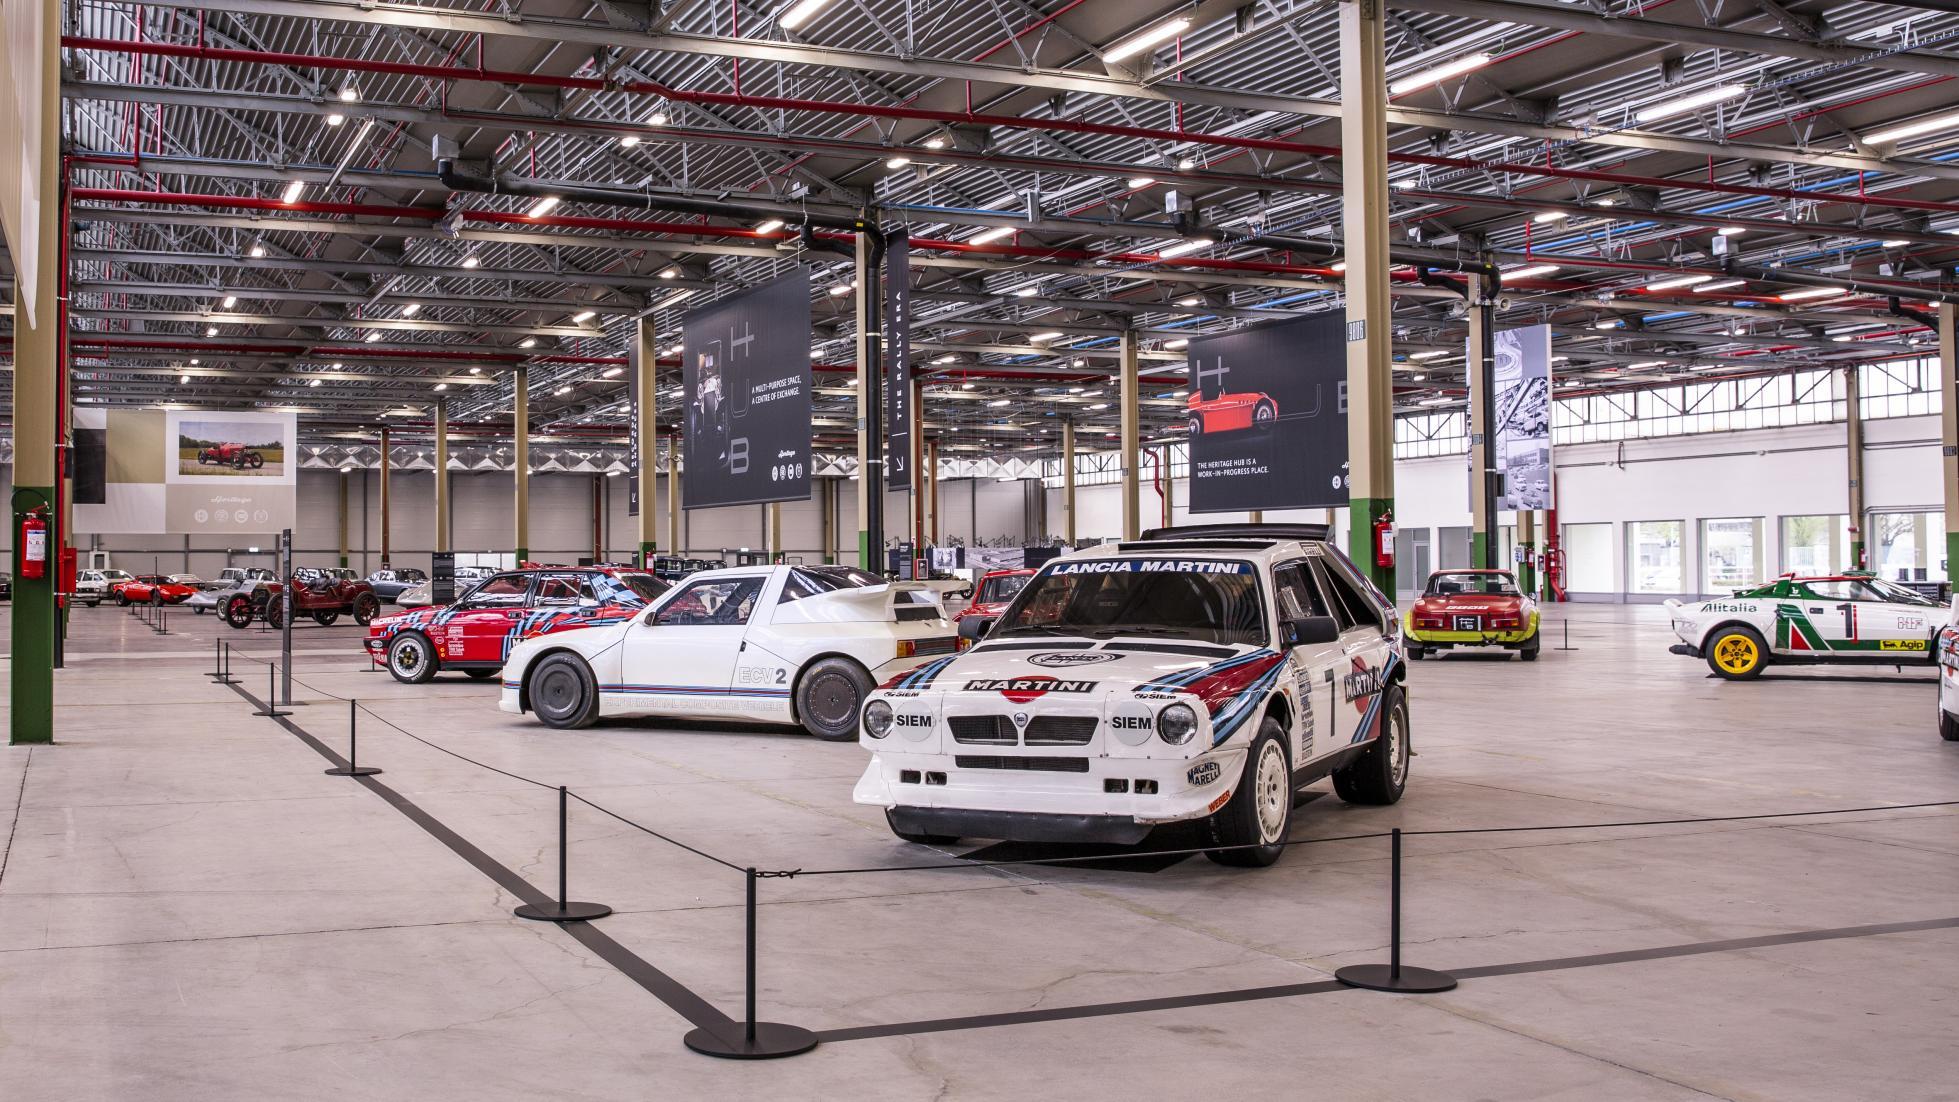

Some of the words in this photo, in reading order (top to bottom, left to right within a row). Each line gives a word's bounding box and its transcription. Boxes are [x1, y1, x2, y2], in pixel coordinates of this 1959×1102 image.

[755, 379, 787, 393] MULTI-PURPOSE
[755, 393, 770, 404] CENTRE
[771, 393, 776, 401] OF
[1208, 459, 1233, 469] HERITAGE
[1234, 459, 1245, 467] HUB
[1246, 458, 1251, 466] IS
[1197, 467, 1250, 478] WORK-IN-PROGRESS
[1250, 466, 1270, 474] PLACE.
[1050, 563, 1132, 576] LANCIA
[1140, 561, 1240, 574] MARTINI
[1701, 603, 1757, 613] Alitalia
[1836, 603, 1853, 638] 1
[1900, 641, 1924, 650] Agip
[965, 680, 1095, 692] MARTINI
[896, 715, 932, 728] SIEM
[1112, 717, 1152, 730] SIEM
[1208, 790, 1231, 813] WEBER
